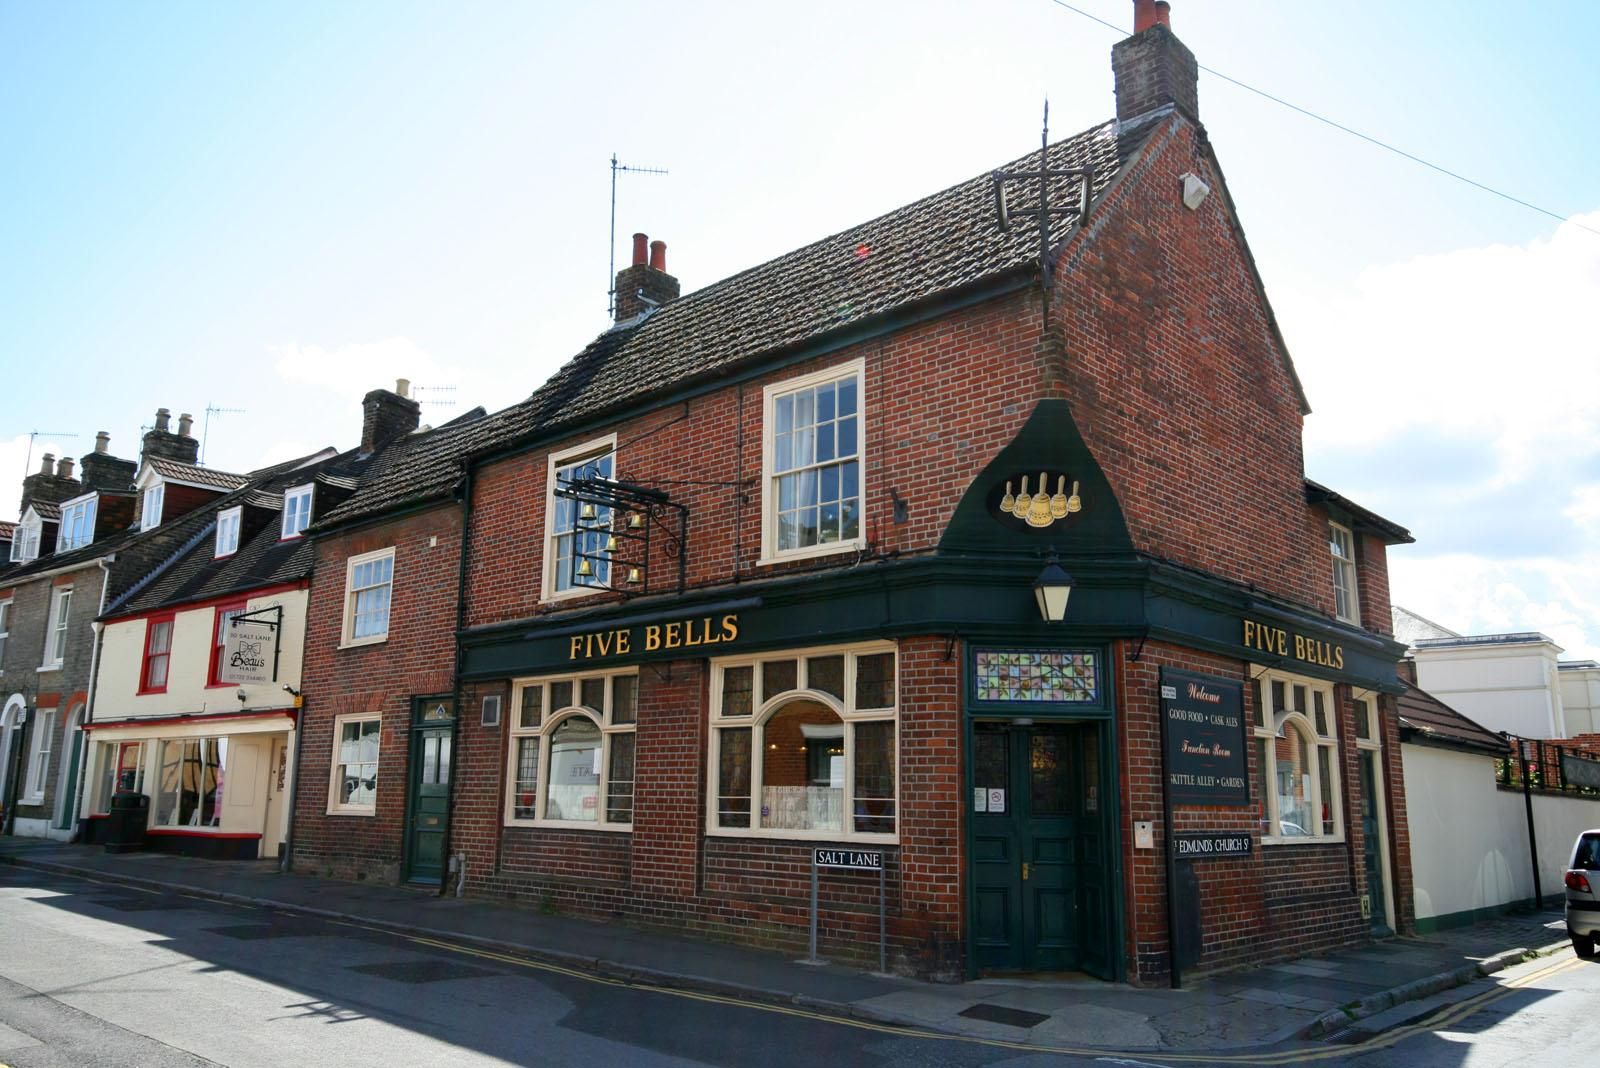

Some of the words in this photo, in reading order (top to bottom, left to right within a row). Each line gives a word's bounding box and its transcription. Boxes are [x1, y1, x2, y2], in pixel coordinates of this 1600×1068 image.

[569, 628, 631, 660] FIVE
[645, 614, 738, 651] BELLS
[1243, 619, 1288, 656] FIVE
[1294, 634, 1344, 670] BELLS
[1188, 682, 1221, 702] Welcome
[1169, 708, 1187, 721] GOOD
[1188, 711, 1204, 723] FOOD
[1210, 714, 1224, 726] CASK
[1225, 716, 1238, 728] ALES
[1181, 739, 1211, 756] Function
[1212, 743, 1231, 757] Room
[1197, 775, 1215, 787] ALLEY
[1220, 777, 1245, 788] GARDEN
[1214, 838, 1242, 852] CHURCH
[818, 851, 846, 864] SALT
[849, 852, 879, 866] LANE
